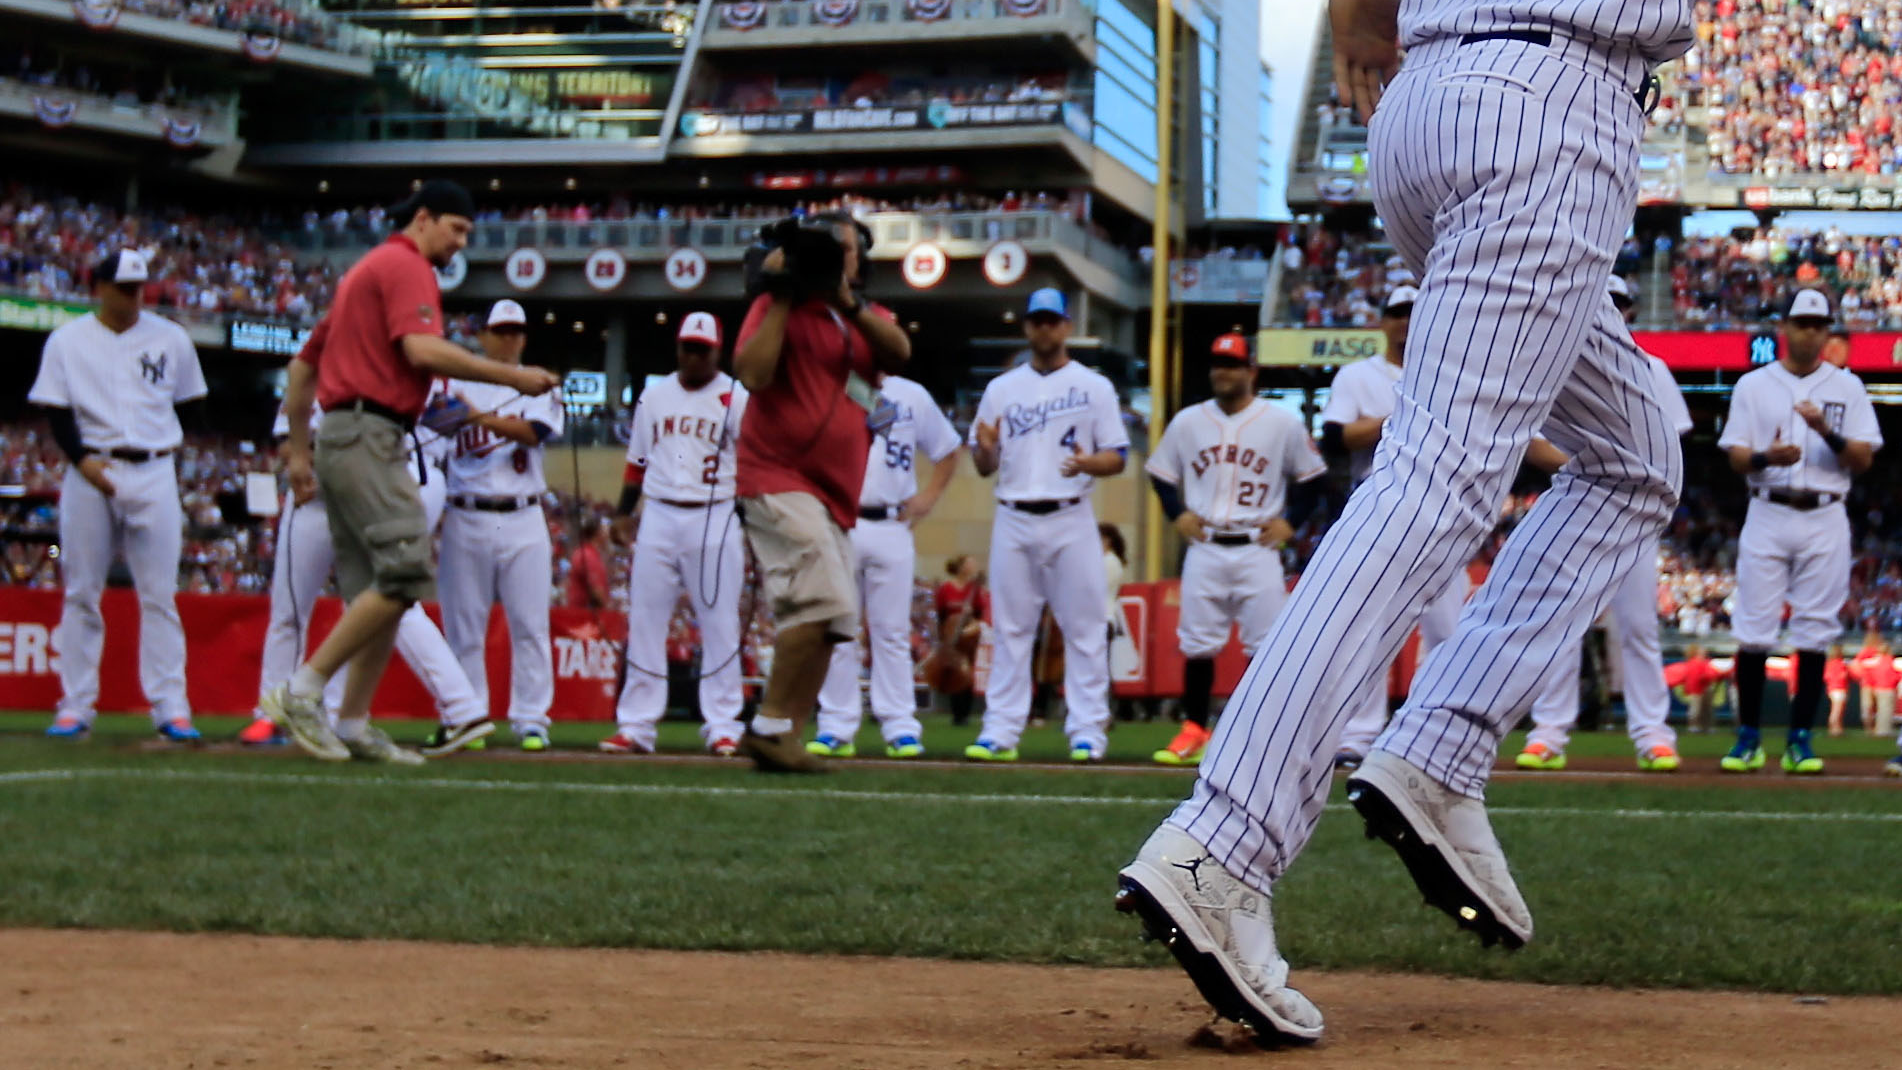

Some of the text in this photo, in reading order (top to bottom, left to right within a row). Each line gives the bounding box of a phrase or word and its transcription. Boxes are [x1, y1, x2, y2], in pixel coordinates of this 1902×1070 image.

[675, 260, 697, 277] 34
[1312, 337, 1378, 357] #ASG
[1005, 386, 1089, 438] Royals
[703, 455, 719, 484] 2
[885, 441, 913, 471] 56
[1191, 444, 1270, 478] ASTROS
[1238, 481, 1269, 508] 27
